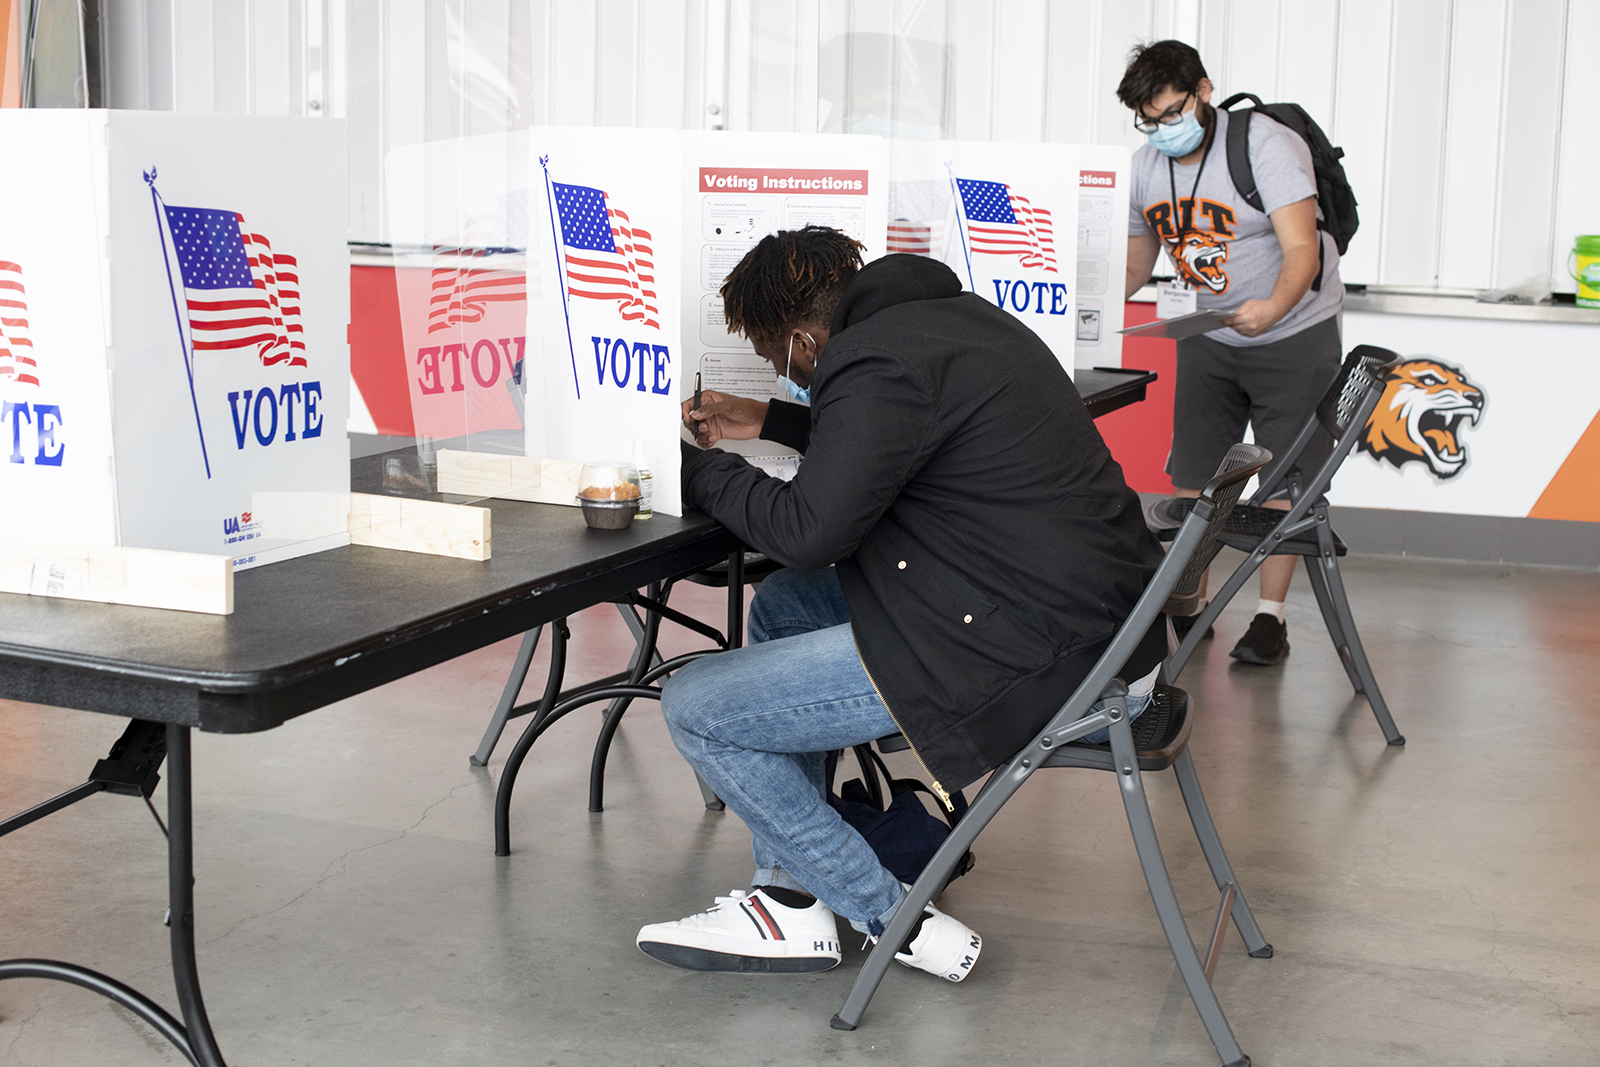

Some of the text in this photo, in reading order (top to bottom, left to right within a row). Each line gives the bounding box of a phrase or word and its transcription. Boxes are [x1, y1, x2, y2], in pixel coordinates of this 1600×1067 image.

[704, 174, 863, 191] Voting Instructions
[1143, 197, 1239, 240] RIT
[992, 279, 1068, 315] VOTE
[591, 336, 671, 395] VOTE
[227, 381, 324, 450] VOTE
[224, 516, 240, 535] UA
